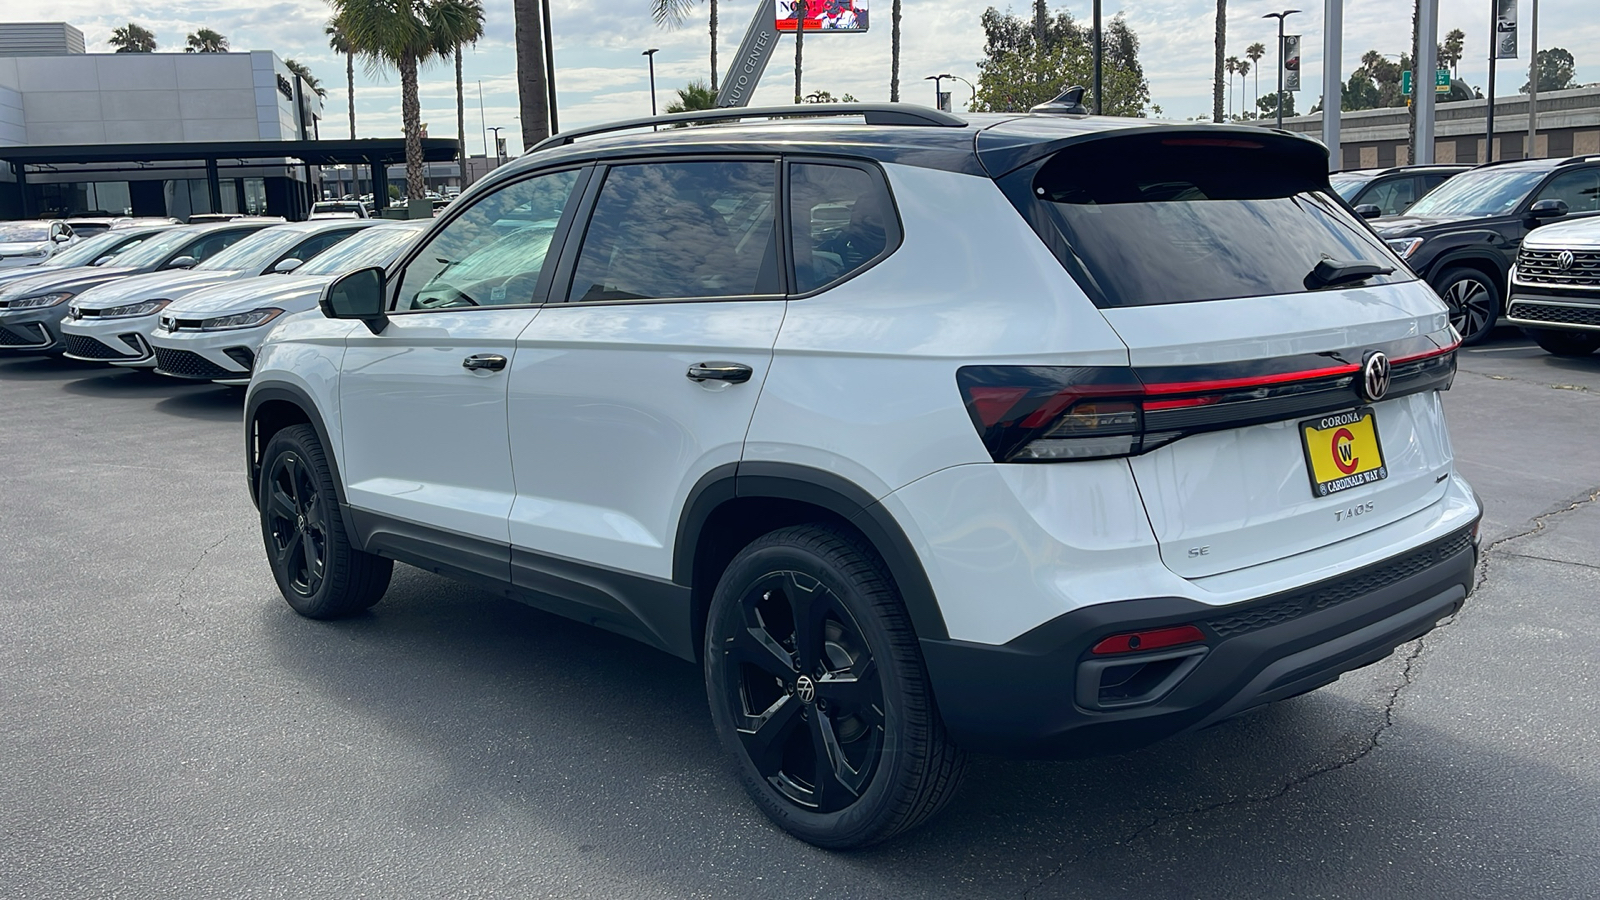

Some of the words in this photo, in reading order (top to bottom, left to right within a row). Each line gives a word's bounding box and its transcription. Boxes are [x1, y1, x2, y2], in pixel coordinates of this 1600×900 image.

[728, 75, 748, 105] AUTO
[744, 30, 770, 74] CENTER
[1321, 412, 1360, 429] CORONA
[1327, 474, 1364, 492] CARDINALE
[1363, 469, 1379, 483] WAY
[1334, 500, 1374, 521] TAOS
[1187, 544, 1210, 559] SE
